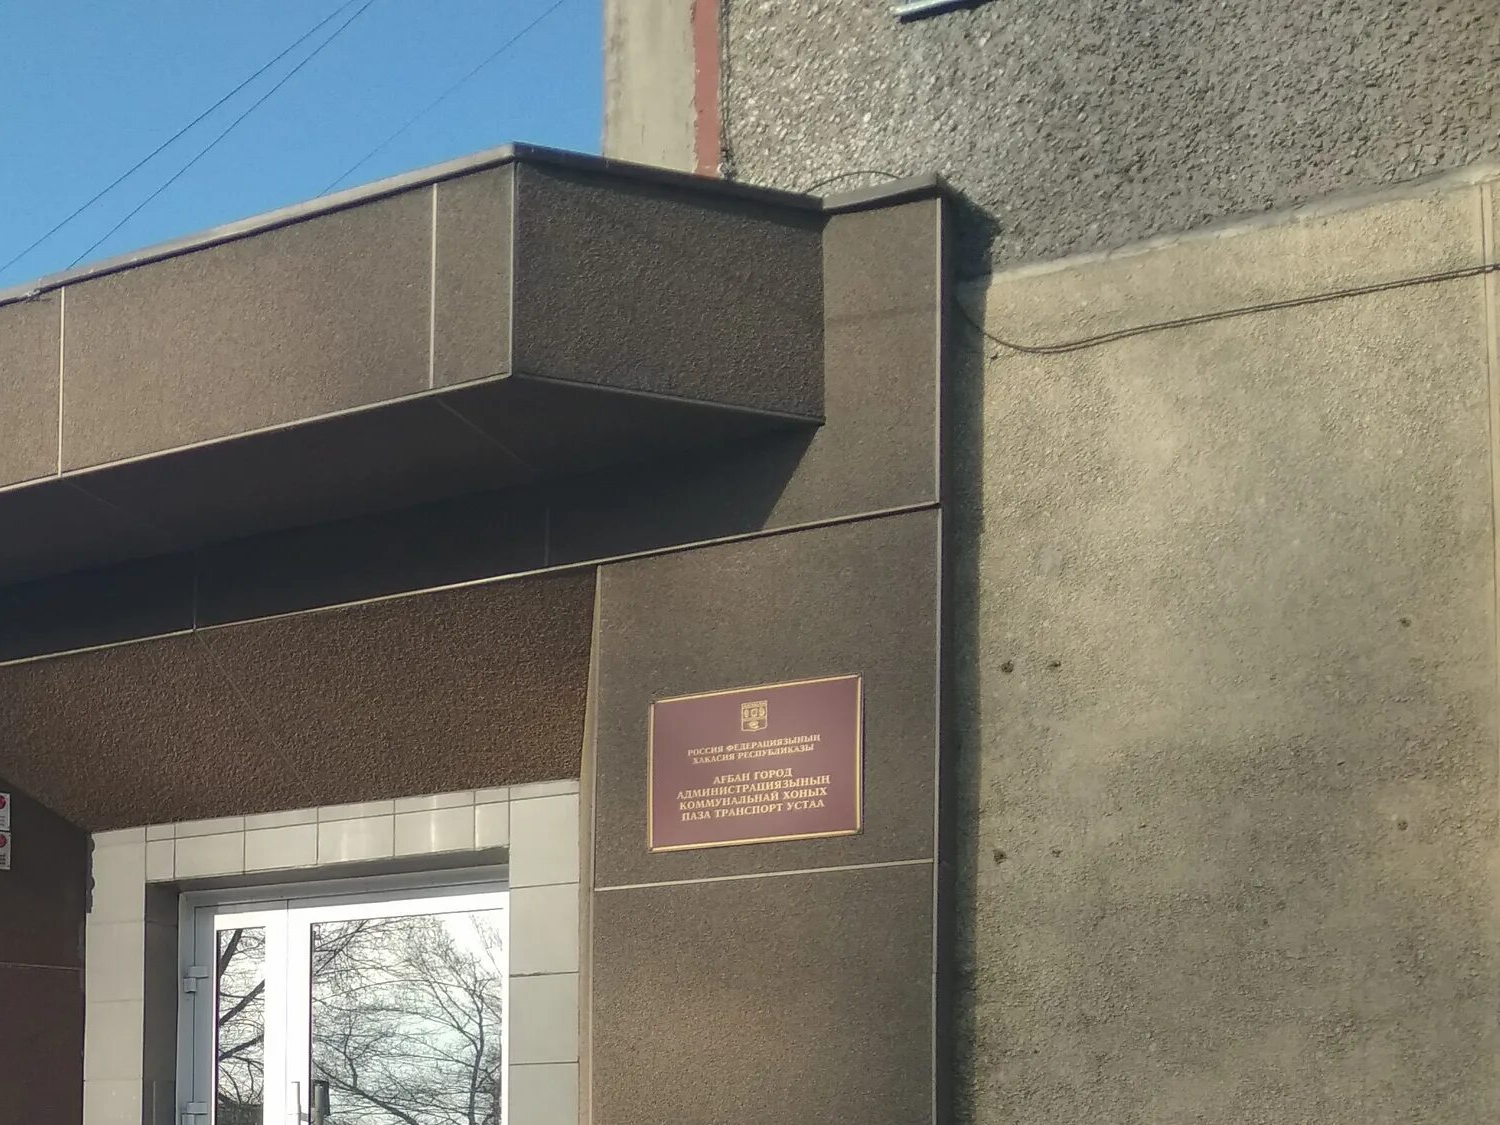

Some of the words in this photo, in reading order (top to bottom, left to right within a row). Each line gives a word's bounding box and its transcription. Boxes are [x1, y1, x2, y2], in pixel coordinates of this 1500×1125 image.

[687, 746, 724, 757] РОССИЯ
[692, 753, 735, 764] ХАКАСИЯ
[754, 767, 793, 780] ГОРОД
[680, 790, 779, 810] КОММУНАЛЬНАЙ
[783, 787, 828, 800] ХОНЫХ
[682, 810, 711, 822] ПАЗА
[714, 803, 783, 818] ТРАНСПОРТ
